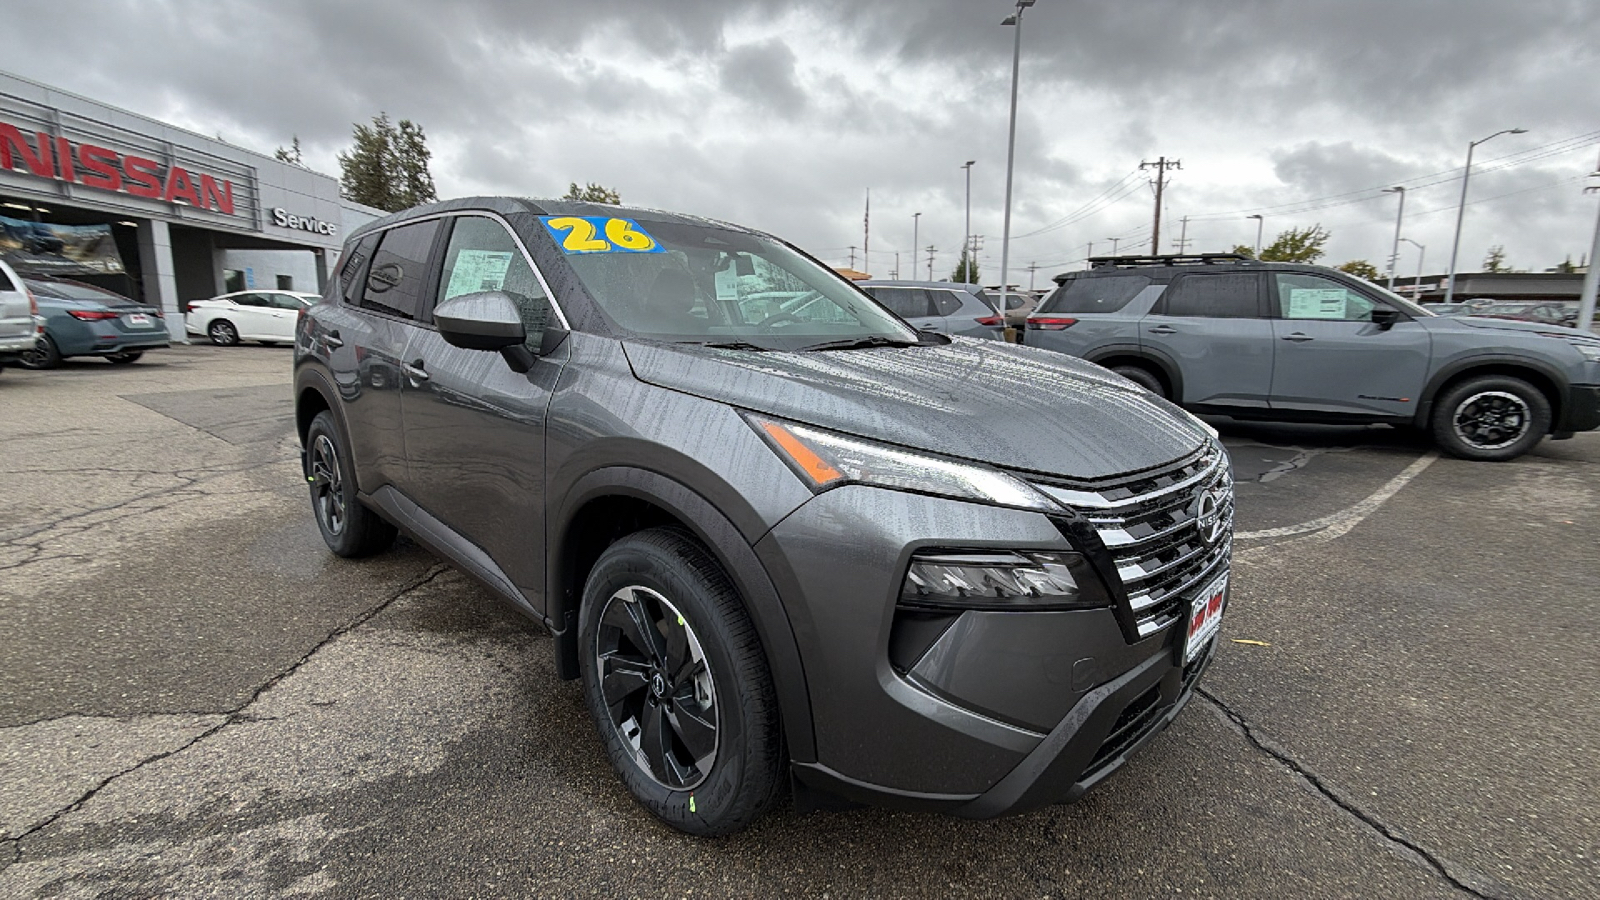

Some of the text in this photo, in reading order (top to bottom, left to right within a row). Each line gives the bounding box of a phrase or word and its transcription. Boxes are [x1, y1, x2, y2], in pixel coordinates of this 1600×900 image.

[0, 122, 234, 214] NISSAN
[273, 207, 337, 236] Service
[547, 217, 655, 252] 26
